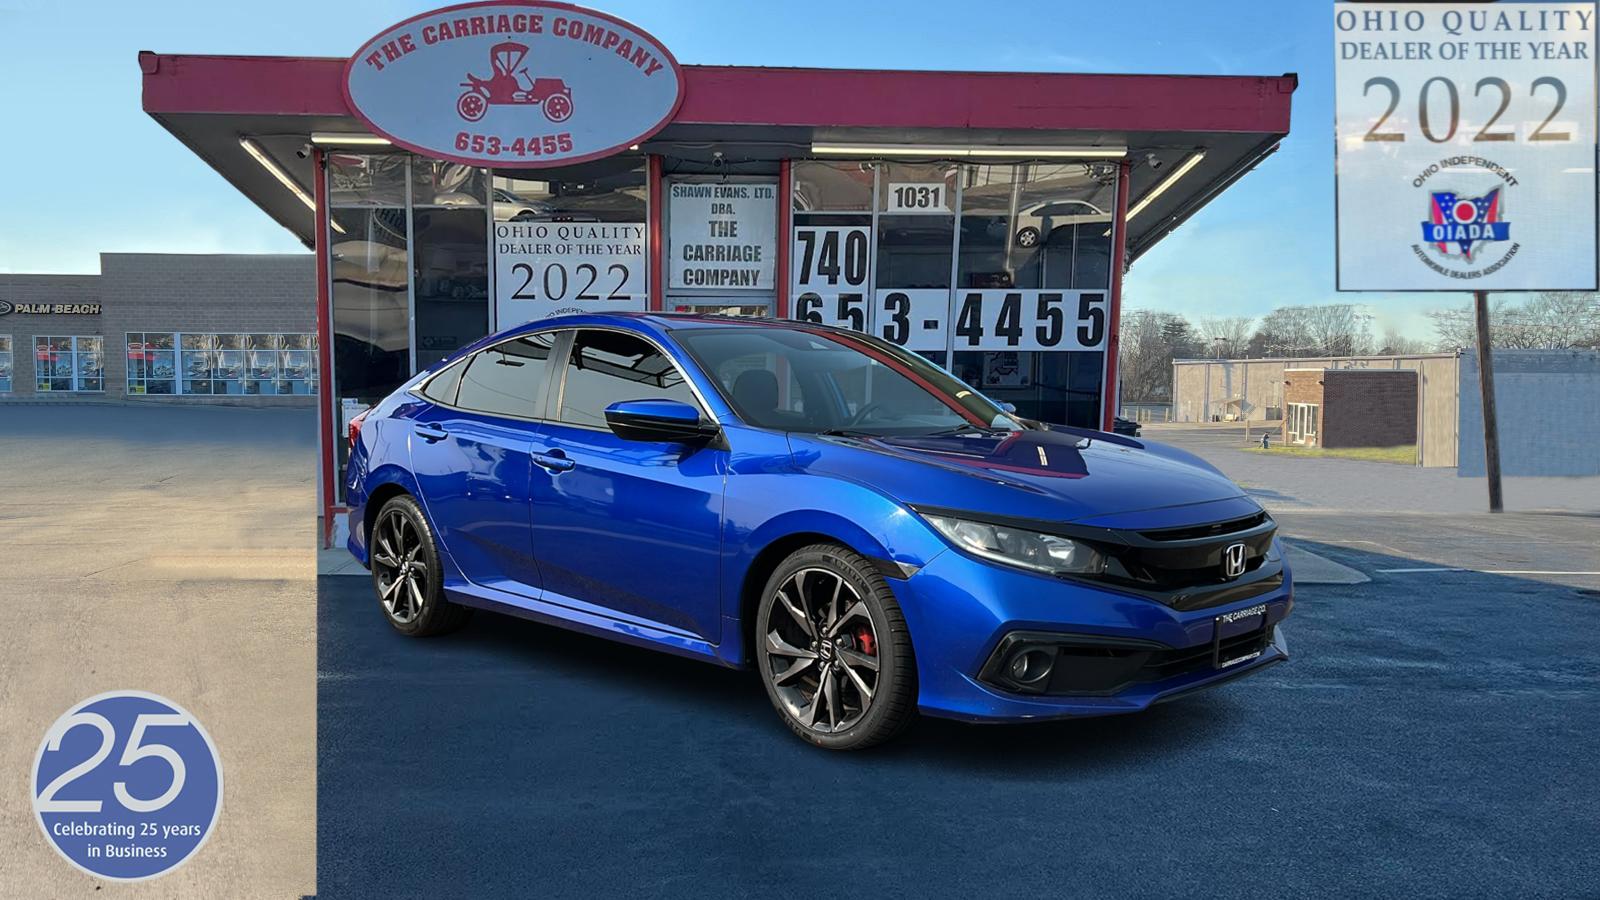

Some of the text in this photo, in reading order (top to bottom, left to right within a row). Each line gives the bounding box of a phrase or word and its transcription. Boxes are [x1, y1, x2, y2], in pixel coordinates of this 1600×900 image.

[1336, 10, 1592, 36] OHIO QUALITY
[366, 14, 664, 77] THE CARRIAGE COMPANY
[1340, 41, 1589, 60] DEALER OF THE YEAR
[1362, 75, 1571, 144] 2022
[454, 132, 573, 157] 653-4455
[1412, 155, 1519, 188] OHIO INDEPENDENT
[672, 186, 712, 200] SHAWN
[754, 187, 775, 200] LTD.
[894, 186, 940, 208] 1031
[711, 203, 736, 215] DBA.
[496, 225, 644, 241] OHIO QUALITY
[708, 220, 738, 238] THE
[1432, 224, 1495, 240] OIADA
[499, 243, 642, 255] DEALER OF THE YEAR
[682, 244, 762, 262] CARRIAGE
[797, 230, 867, 286] 740
[510, 262, 632, 302] 2022
[683, 268, 761, 286] COMPANY
[15, 304, 99, 314] PALM BEACH
